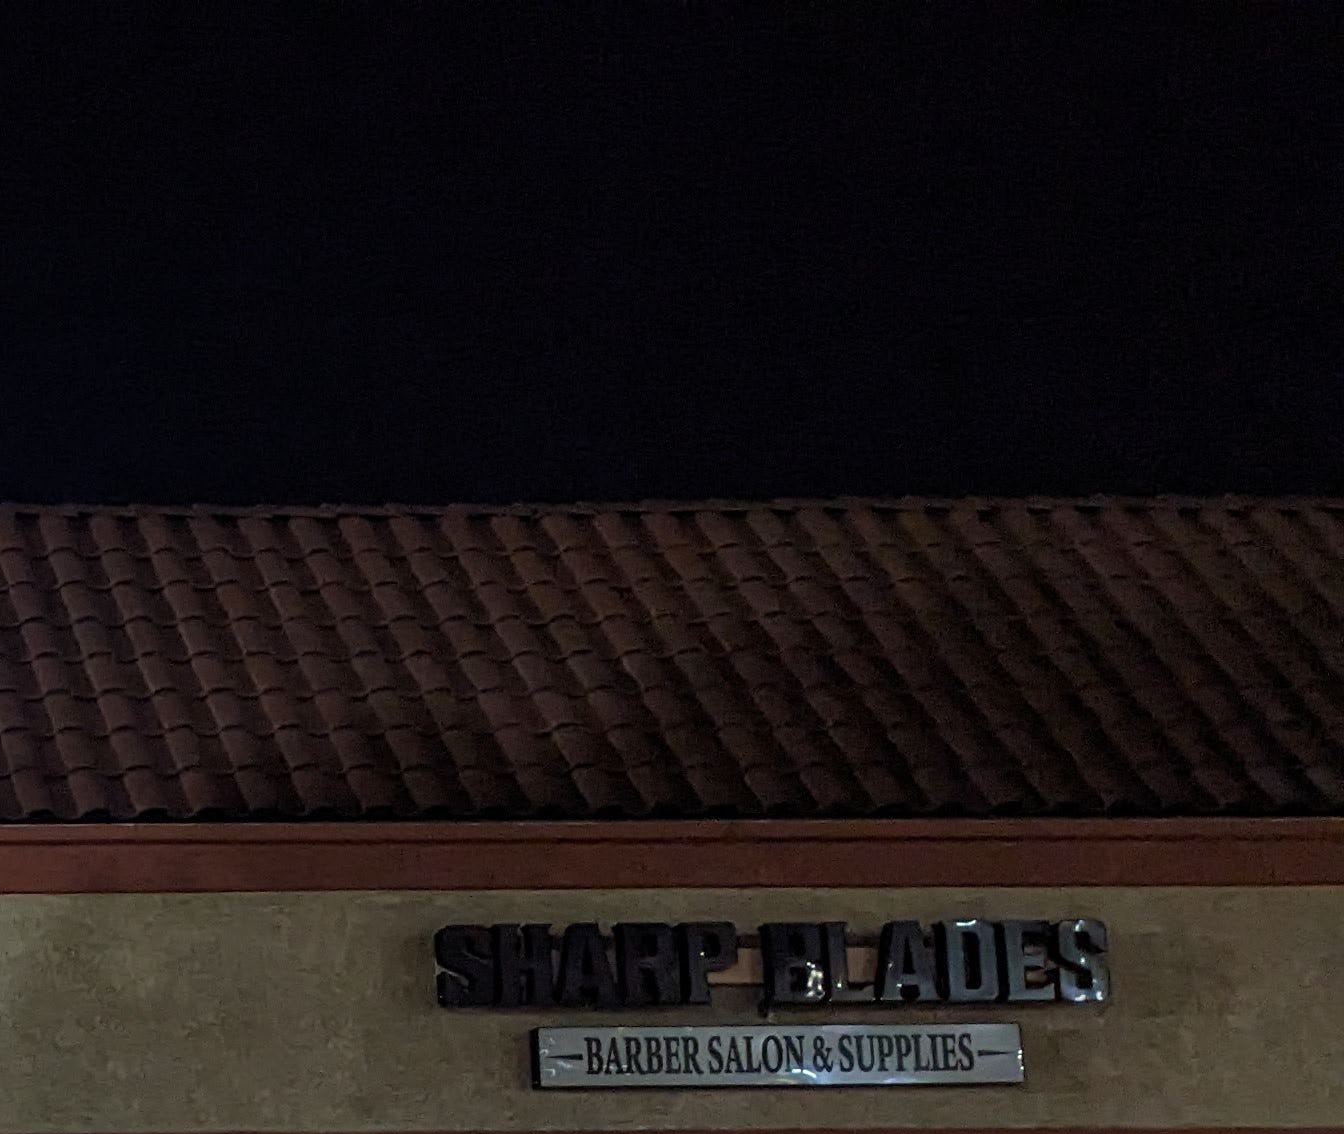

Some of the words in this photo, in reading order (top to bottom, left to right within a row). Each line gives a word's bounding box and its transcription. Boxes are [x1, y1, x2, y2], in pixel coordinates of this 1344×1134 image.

[434, 921, 738, 1005] SHARP
[758, 917, 1110, 1006] BLADES
[584, 1036, 700, 1075] BARBER
[708, 1036, 805, 1074] SALON
[812, 1036, 832, 1072] &
[837, 1033, 975, 1072] SUPPLIES
